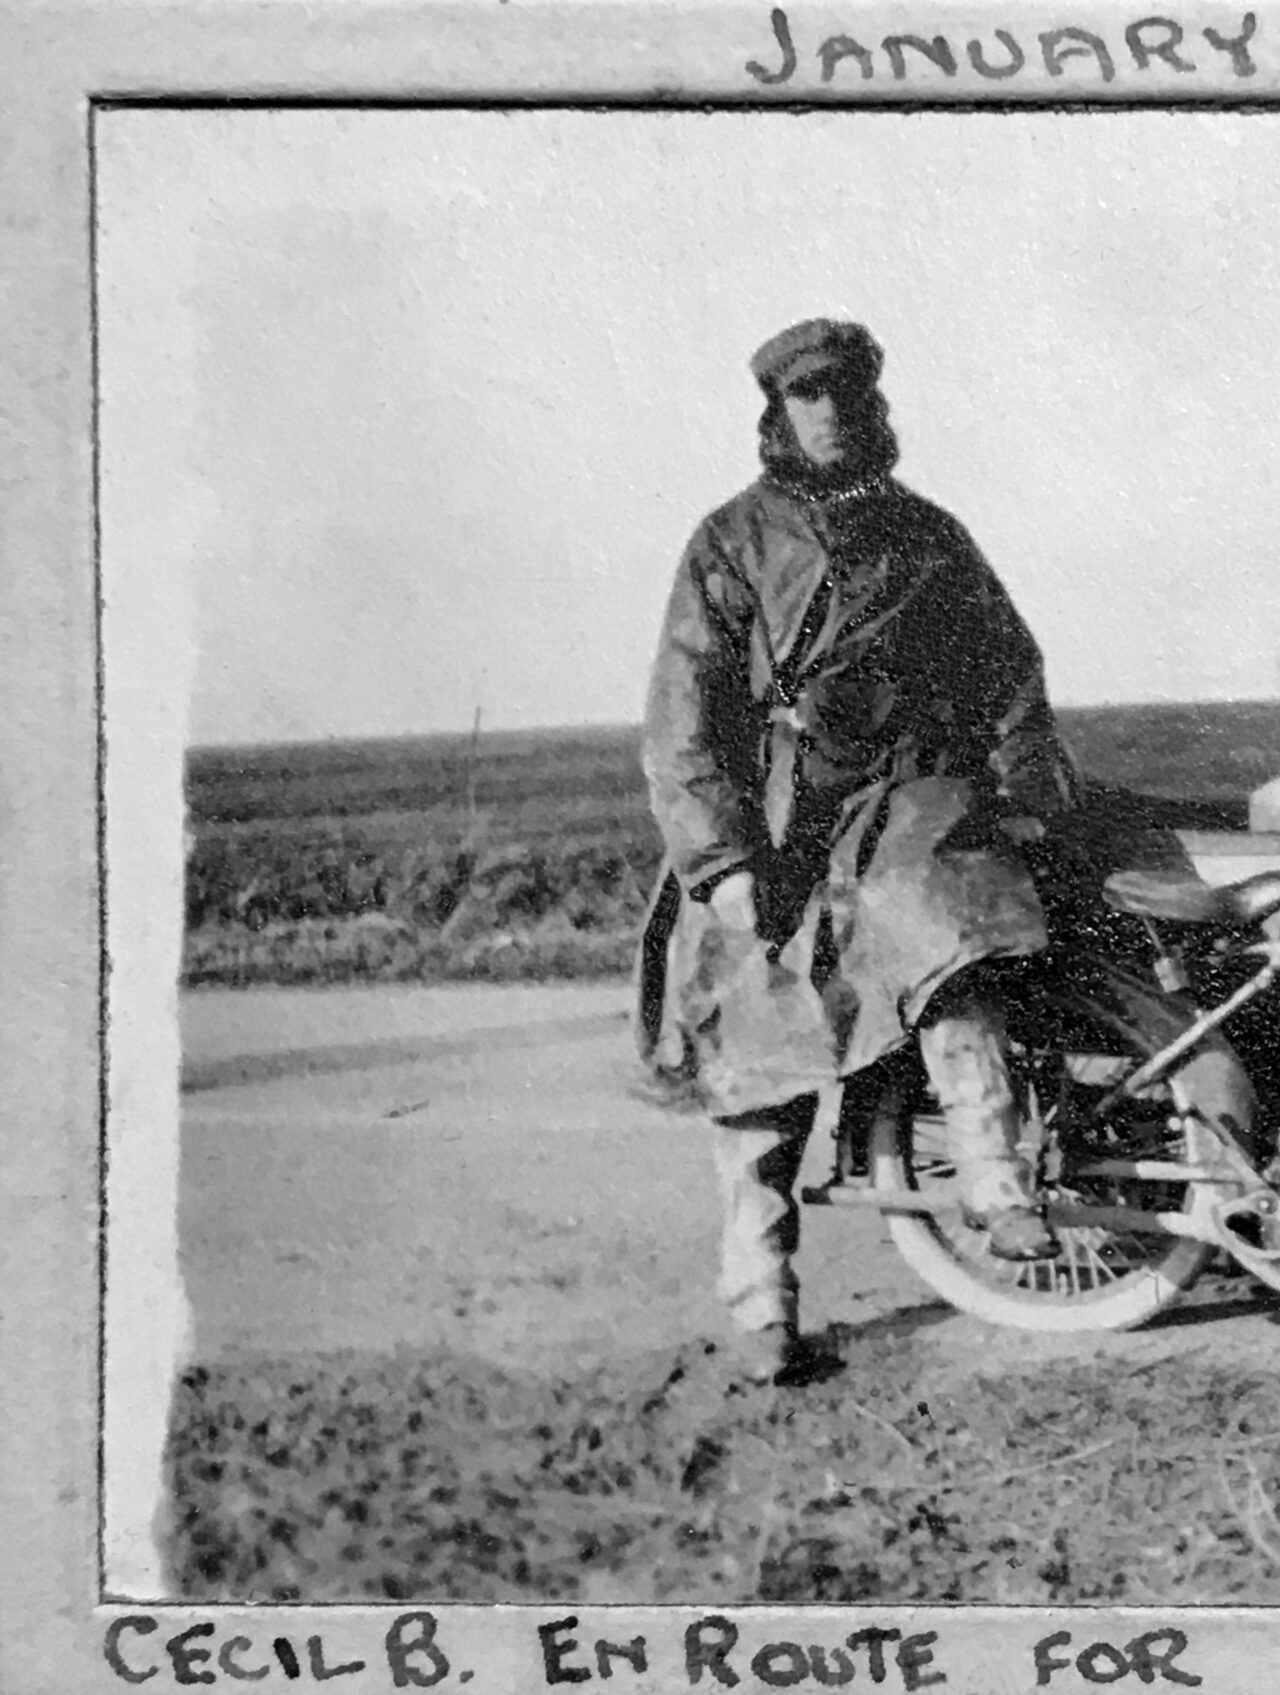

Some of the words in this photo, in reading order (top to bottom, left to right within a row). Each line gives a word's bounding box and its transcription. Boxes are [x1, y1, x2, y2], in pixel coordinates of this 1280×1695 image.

[746, 8, 1257, 85] JANUARY
[103, 1615, 366, 1686] CECIL
[385, 1611, 475, 1688] B.
[537, 1615, 650, 1686] EN
[684, 1614, 948, 1692] ROUTE
[1033, 1627, 1203, 1687] FOR
